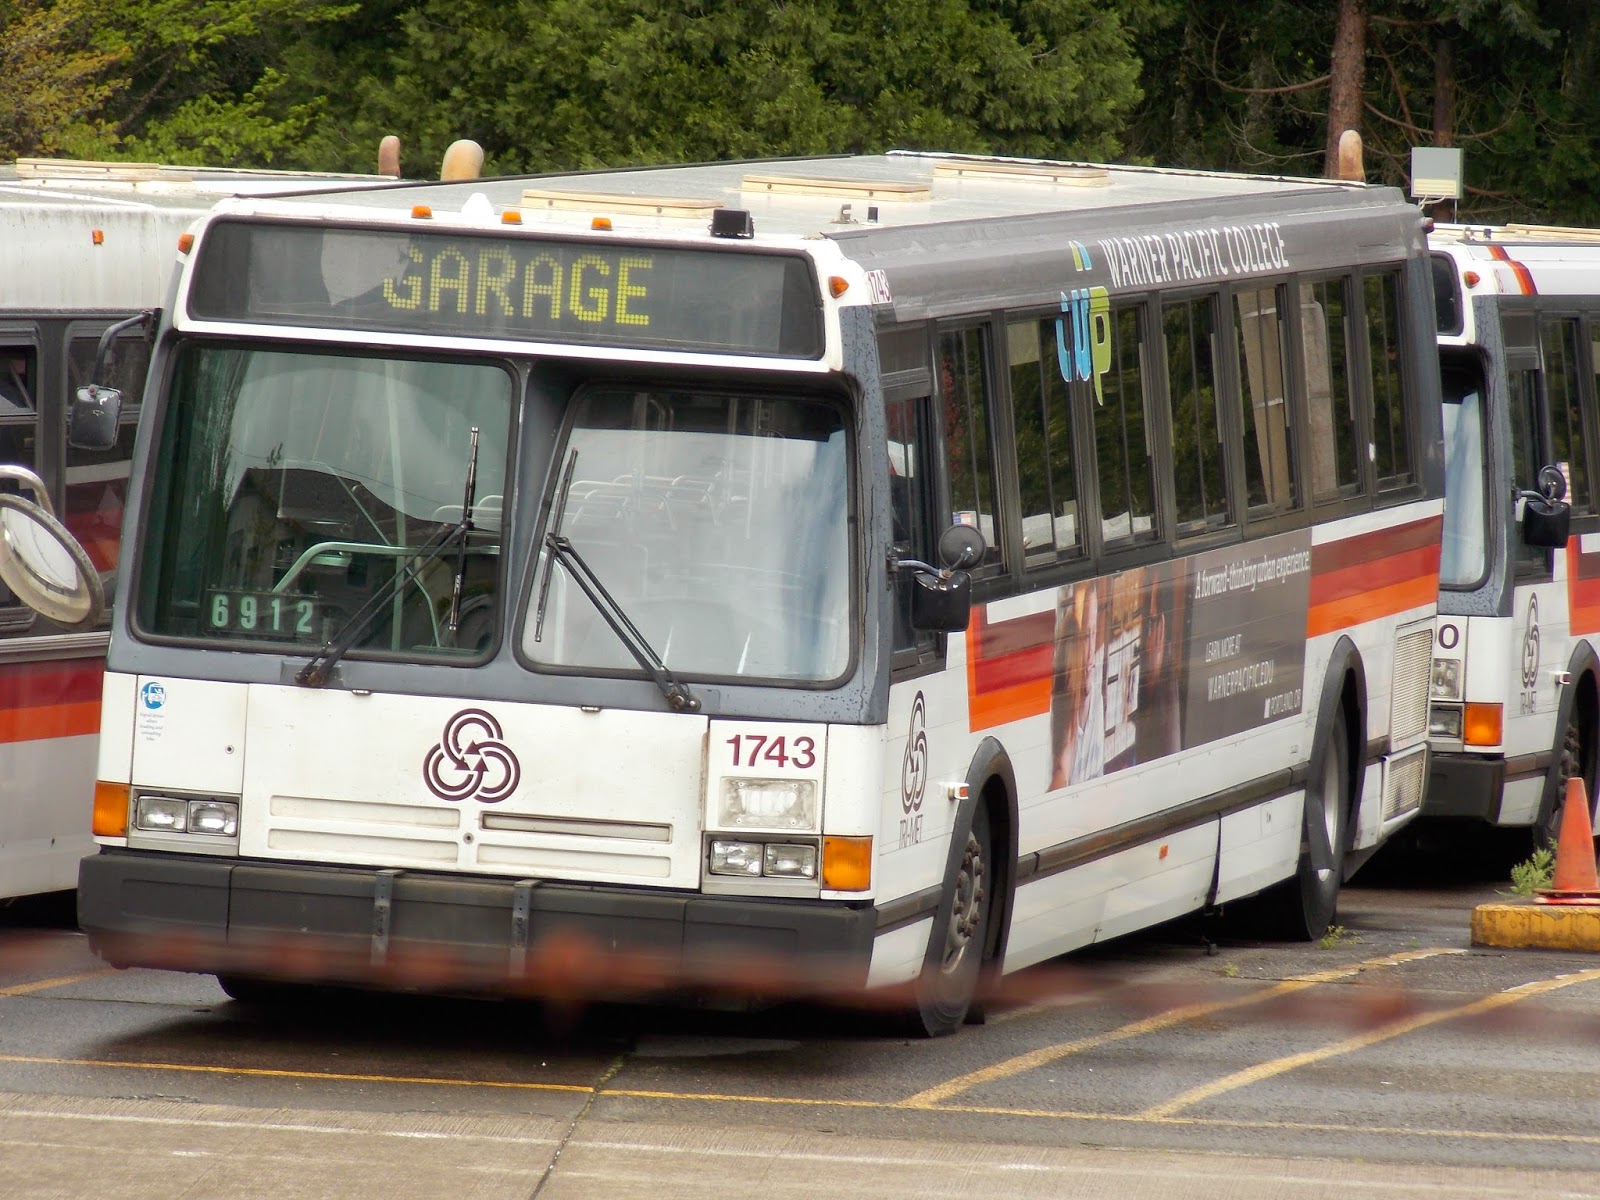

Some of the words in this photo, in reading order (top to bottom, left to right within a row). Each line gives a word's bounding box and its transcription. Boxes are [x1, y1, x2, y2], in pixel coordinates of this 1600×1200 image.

[1098, 235, 1171, 288] WARNER
[1165, 228, 1228, 280] PACIFIC
[1224, 221, 1290, 274] COLLEGE
[383, 245, 653, 326] GARAGE
[1194, 571, 1202, 599] A
[1201, 559, 1258, 597] forward-thinking
[1257, 554, 1276, 583] urban
[211, 594, 314, 634] 6912
[1205, 640, 1221, 663] LEARN
[1221, 635, 1236, 658] MORE
[1235, 633, 1242, 655] AT
[1207, 659, 1275, 702] WARNERPACIFIC.EDU
[726, 733, 816, 769] 1743
[898, 814, 924, 850] TRI-MET
